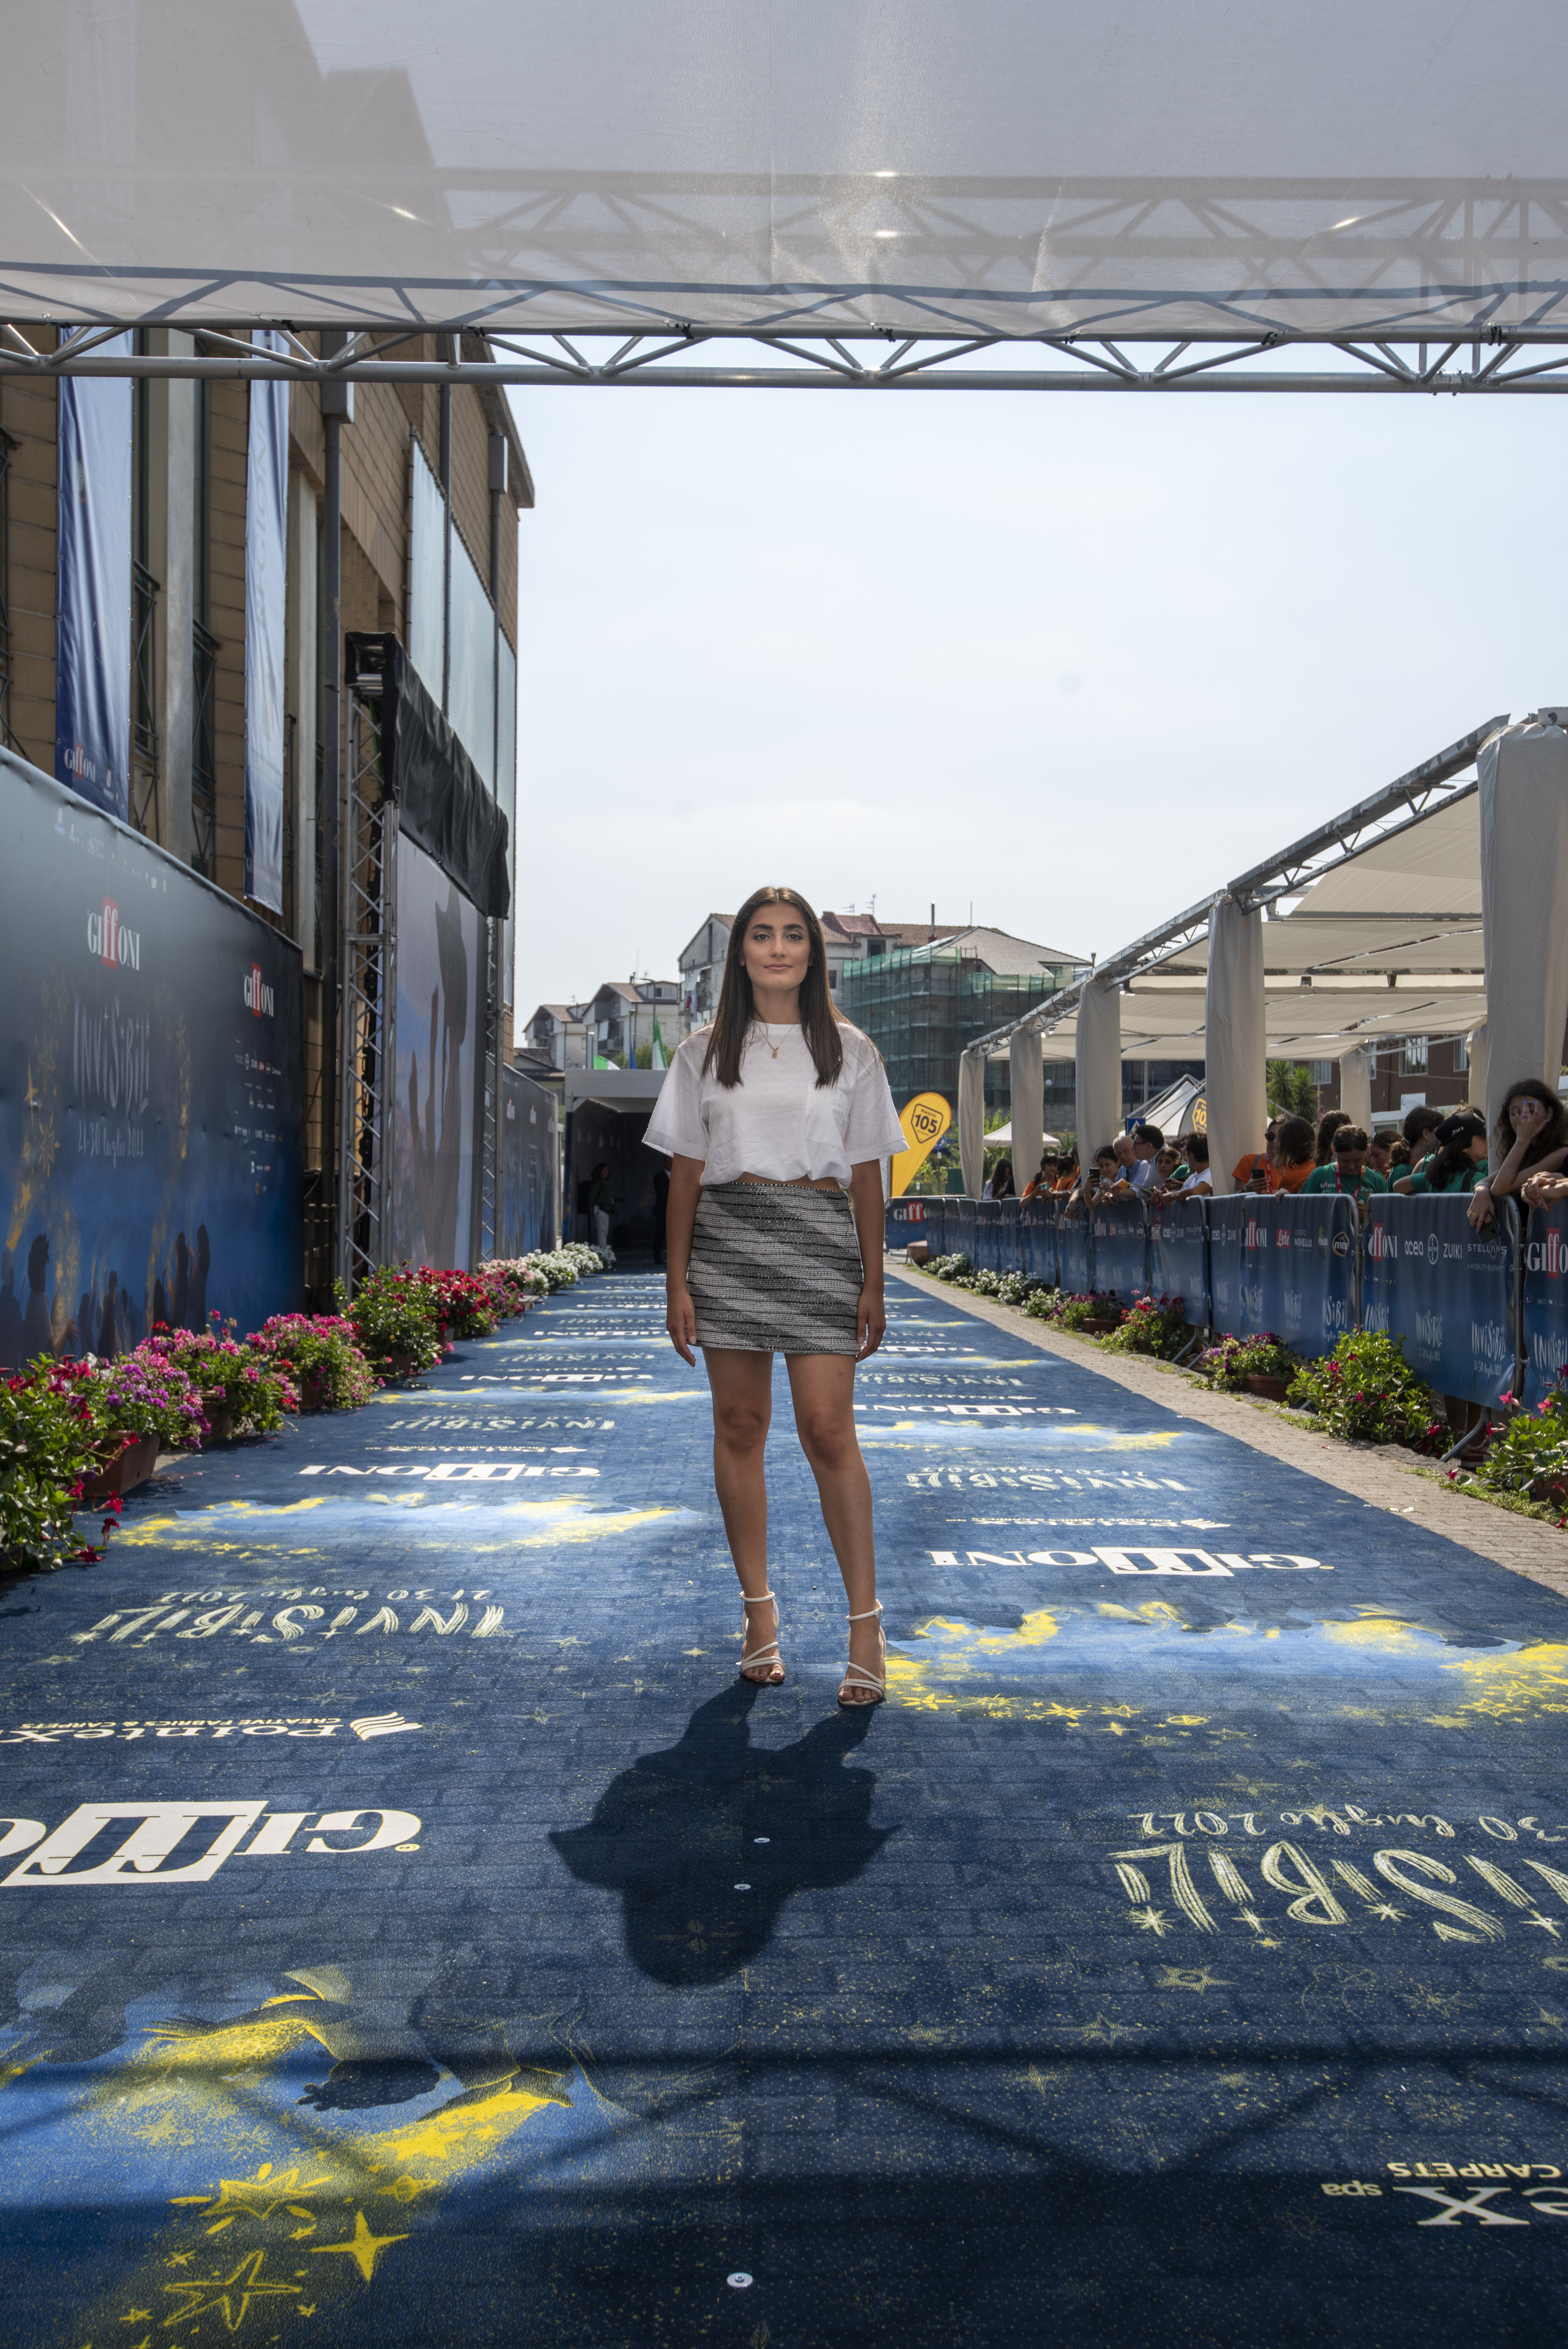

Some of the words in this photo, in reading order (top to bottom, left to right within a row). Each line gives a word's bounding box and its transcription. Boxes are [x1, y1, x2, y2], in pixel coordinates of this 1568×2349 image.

[915, 1113, 938, 1134] 105
[1195, 1108, 1207, 1128] 10
[1404, 1240, 1424, 1256] acea
[1443, 1243, 1462, 1260] ZUIKI
[160, 1591, 247, 1603] 2022
[386, 1589, 491, 1600] 21-30
[1127, 1812, 1267, 1836] 2022
[1387, 2162, 1560, 2178] CARPETS
[1321, 2180, 1383, 2196] spa
